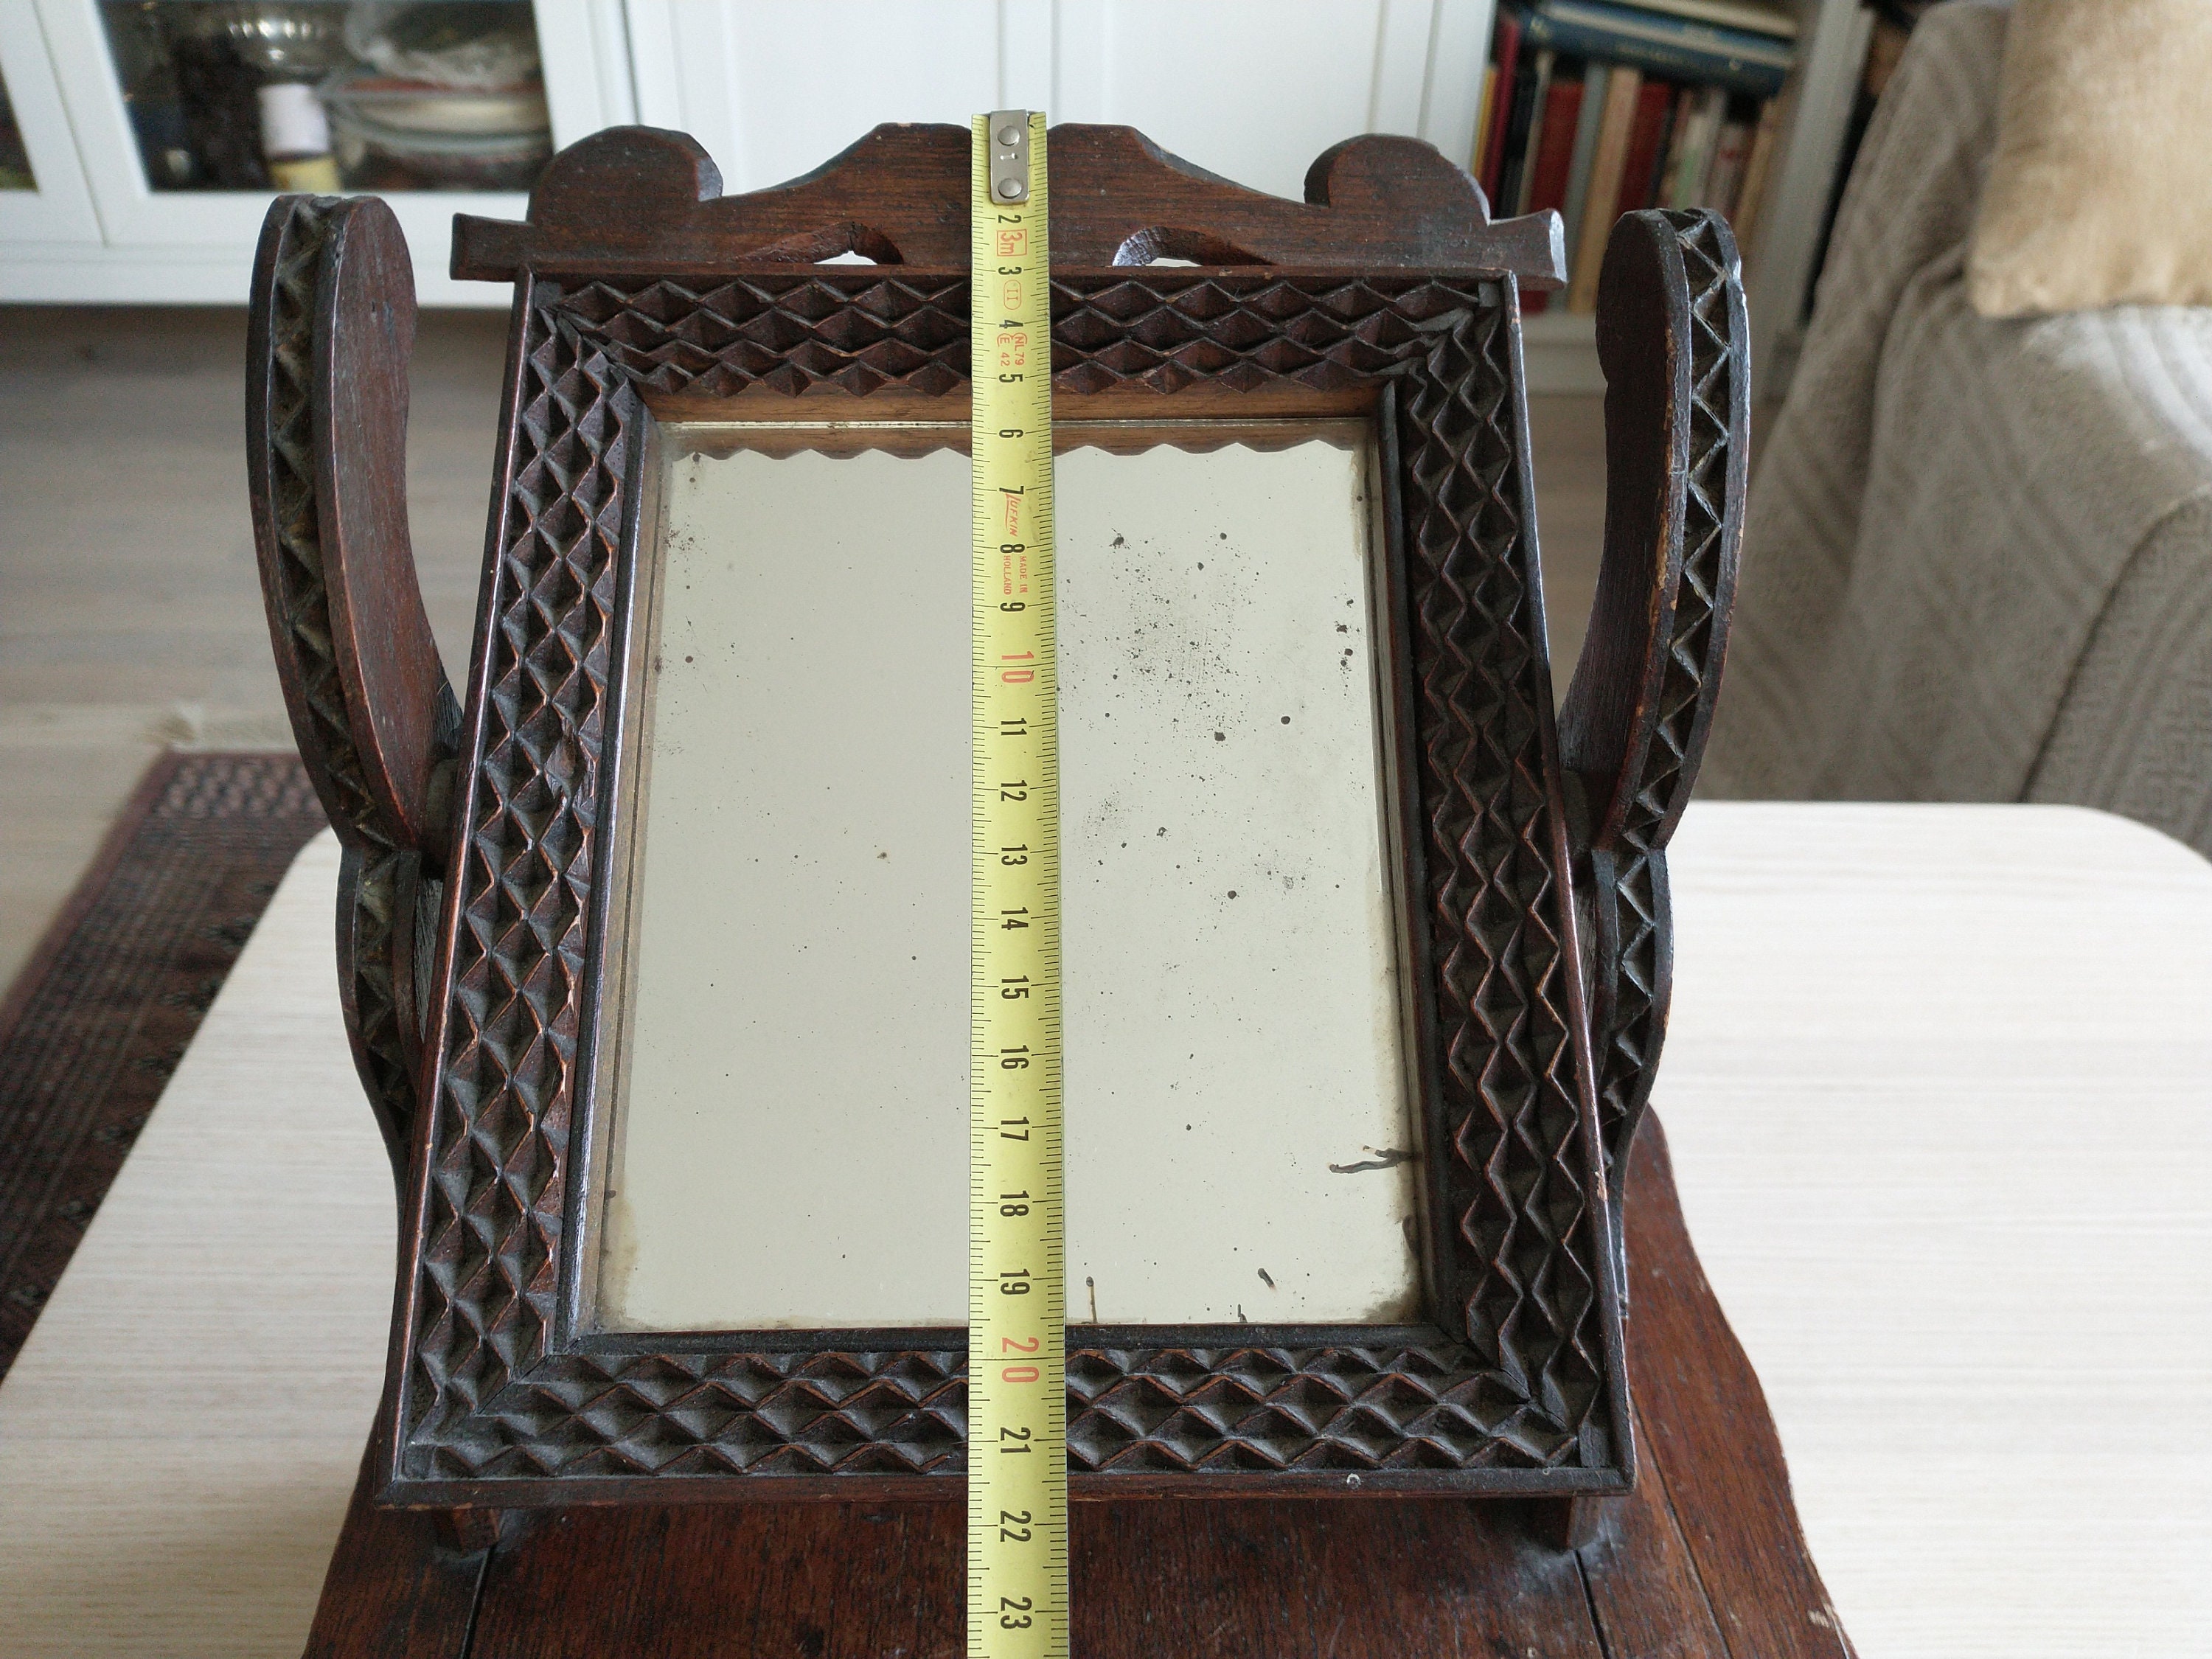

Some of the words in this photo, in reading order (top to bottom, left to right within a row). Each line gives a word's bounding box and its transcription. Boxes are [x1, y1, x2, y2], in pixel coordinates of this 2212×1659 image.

[998, 215, 1022, 223] 2
[1000, 232, 1023, 254] 3m
[998, 266, 1022, 275] 3
[999, 319, 1023, 329] 4
[998, 373, 1023, 383] 5
[998, 429, 1023, 438] 6
[999, 485, 1024, 495] 7
[1000, 544, 1025, 554] 8
[1004, 555, 1012, 595] HOLLAND
[1020, 584, 1028, 594] IN
[1000, 602, 1026, 612] 9
[1001, 651, 1034, 684] 10
[1001, 717, 1027, 736] 11
[1001, 780, 1027, 801] 12
[1001, 844, 1028, 866] 13
[1001, 907, 1029, 930] 14
[1001, 975, 1029, 999] 15
[1001, 1045, 1029, 1069] 16
[1001, 1116, 1029, 1141] 17
[1000, 1190, 1029, 1217] 18
[1000, 1268, 1031, 1295] 19
[1001, 1337, 1040, 1383] 20
[1000, 1427, 1032, 1453] 21
[1000, 1510, 1032, 1543] 22
[1000, 1596, 1032, 1630] 23
